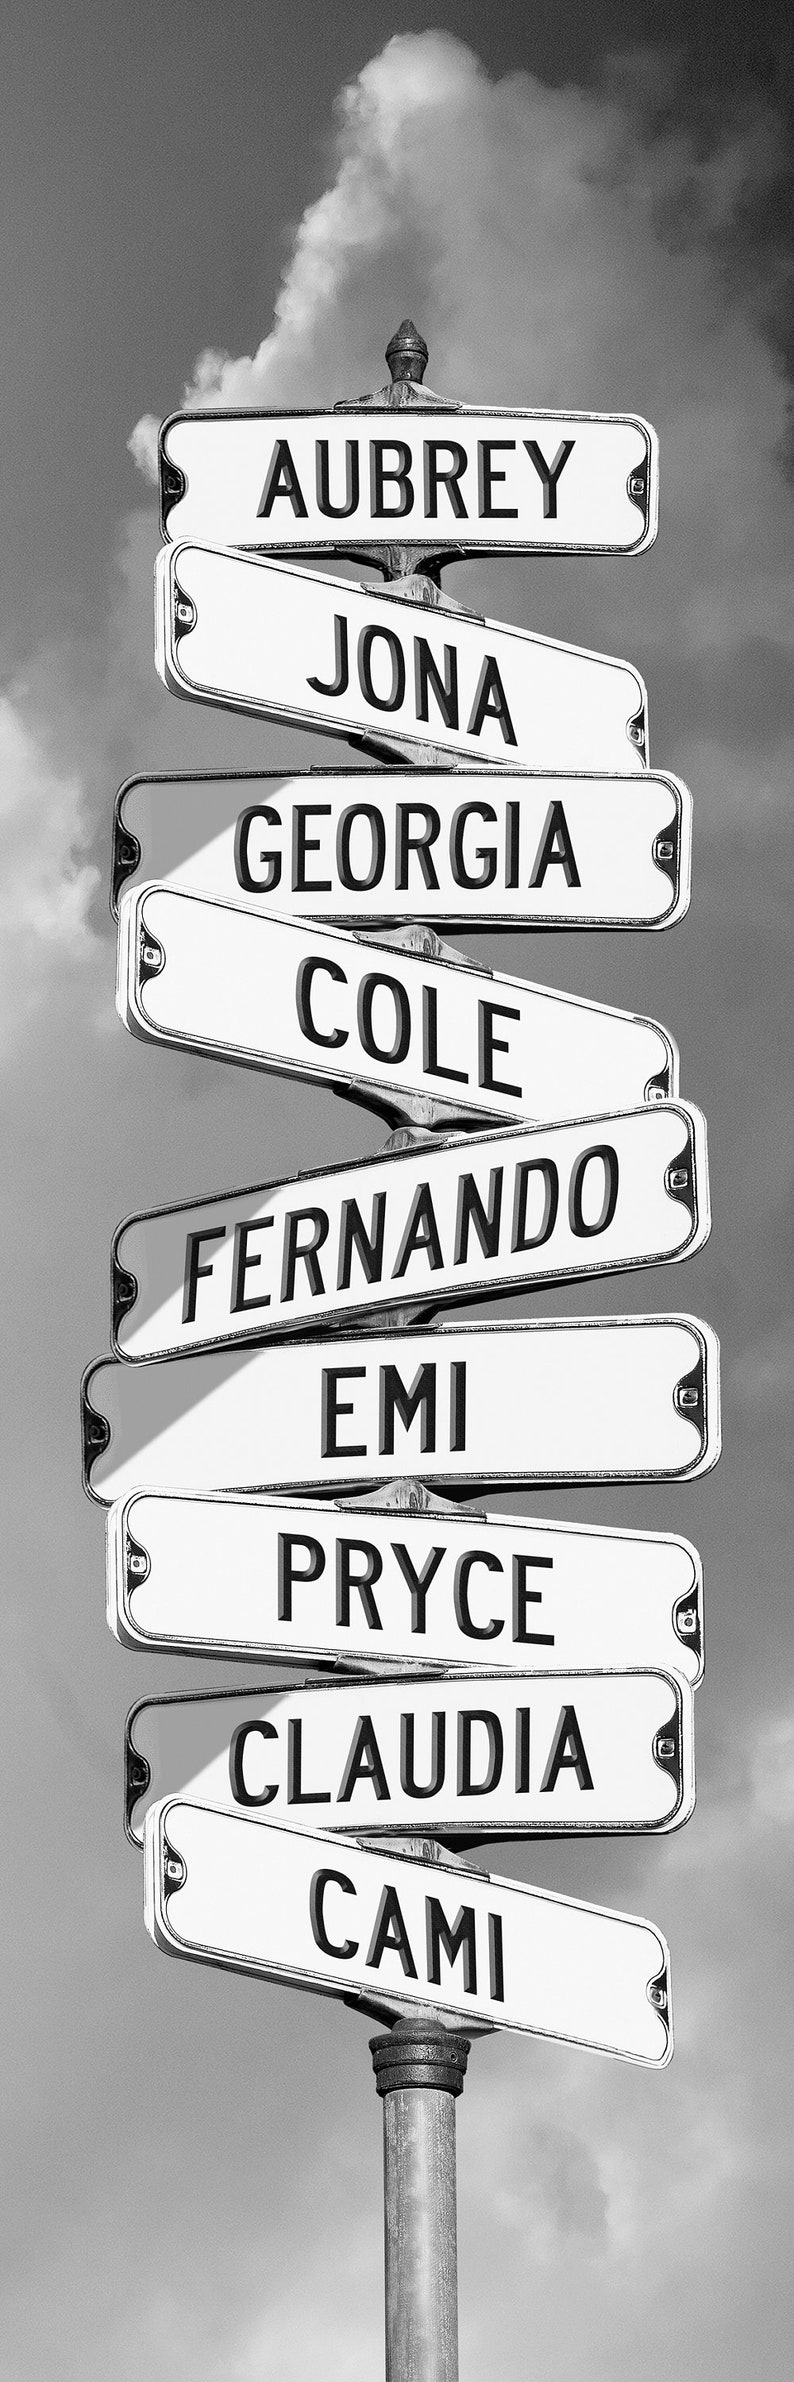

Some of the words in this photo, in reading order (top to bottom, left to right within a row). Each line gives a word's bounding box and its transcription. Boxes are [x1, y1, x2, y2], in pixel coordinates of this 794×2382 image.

[257, 440, 576, 519] AUBREY
[306, 614, 519, 747] JONA
[235, 801, 582, 894] GEORGIA
[297, 957, 523, 1099] COLE
[182, 1145, 620, 1324] FERNANDO
[320, 1362, 468, 1459] EMI
[277, 1533, 556, 1646] PRYCE
[229, 1706, 595, 1808] CLAUDIA
[310, 1869, 506, 2003] CAMI
